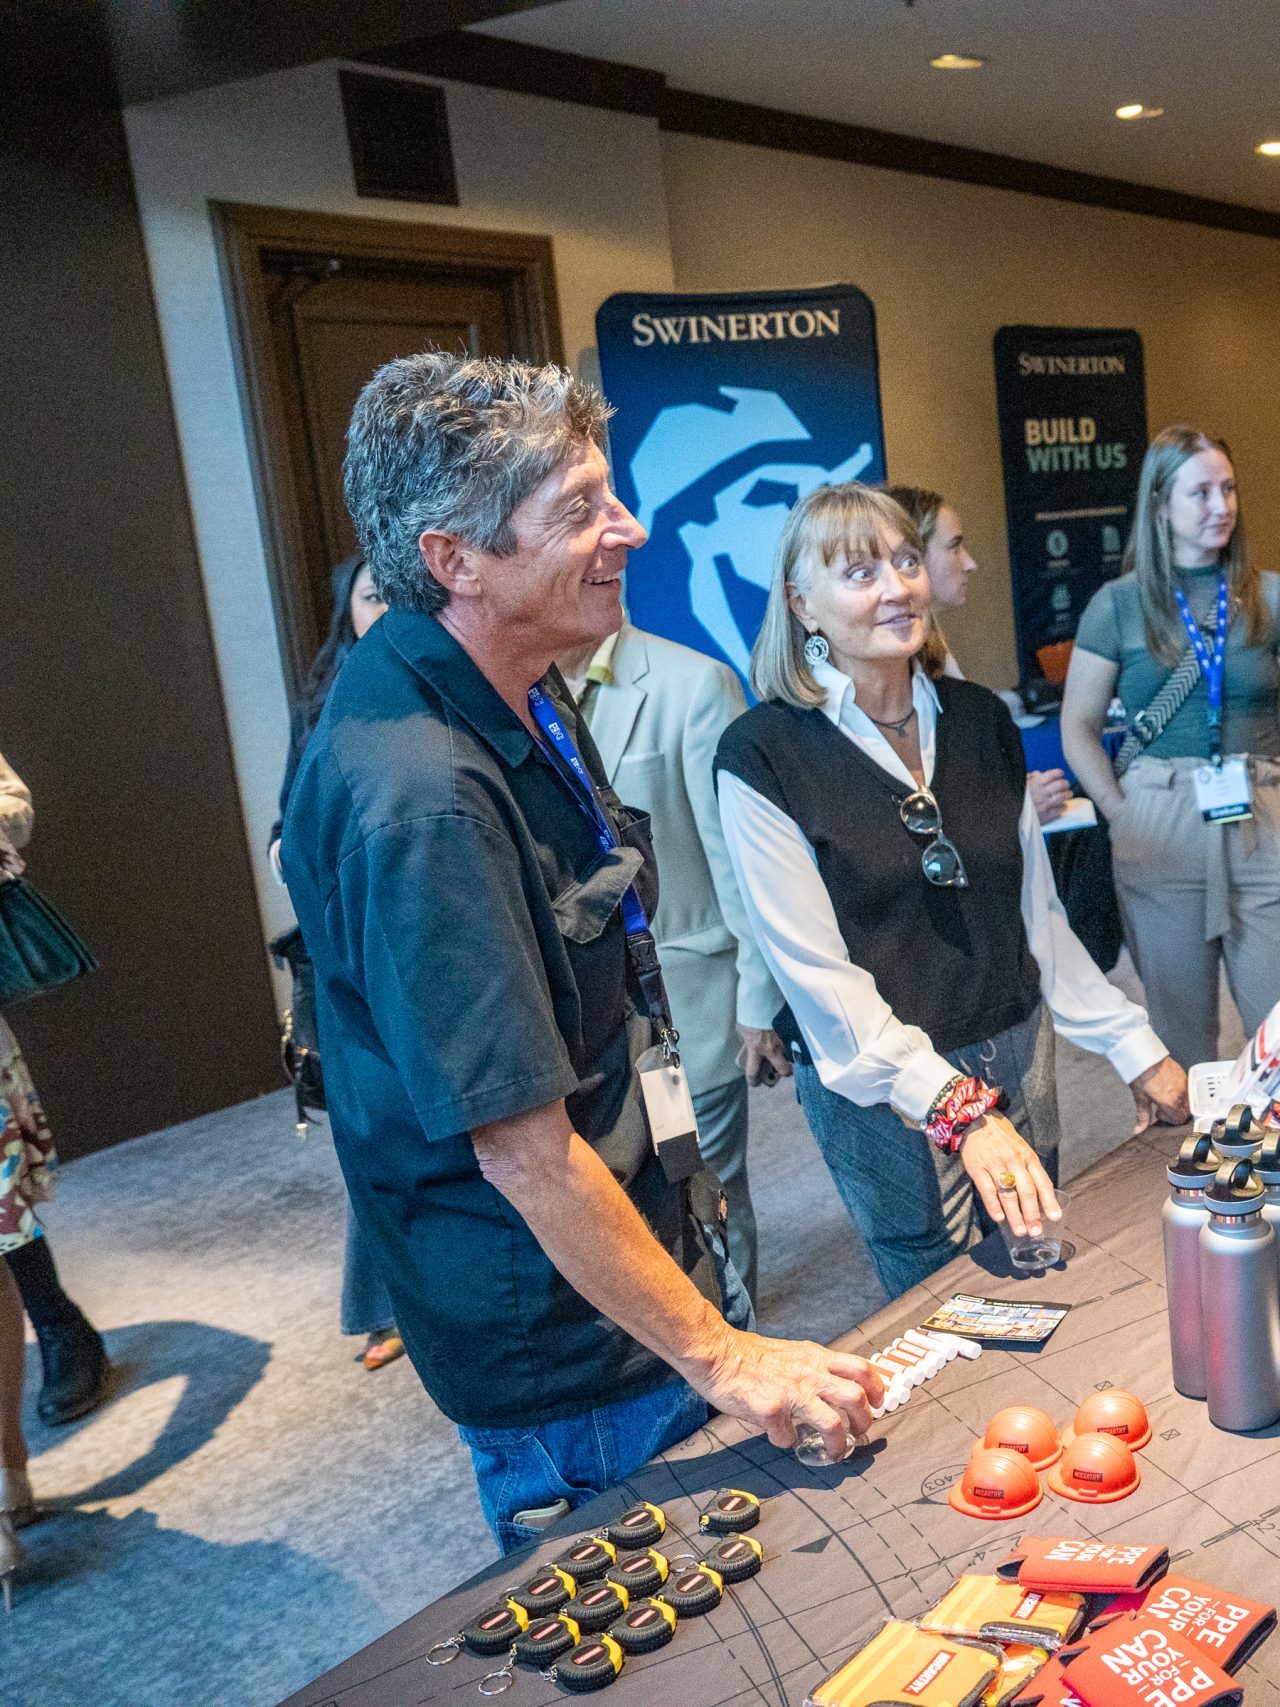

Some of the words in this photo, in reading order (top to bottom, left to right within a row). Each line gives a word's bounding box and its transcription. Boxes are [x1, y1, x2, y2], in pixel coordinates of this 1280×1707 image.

[632, 308, 841, 348] SWINERTON
[1024, 416, 1098, 446] BUILD
[1025, 444, 1092, 473] WITH
[1094, 441, 1128, 470] US
[1044, 1540, 1087, 1561] CAN
[1072, 1543, 1107, 1562] YOUR
[1106, 1545, 1150, 1565] PPE
[1167, 1595, 1212, 1632] YOUR
[1191, 1607, 1217, 1627] FOR
[1195, 1603, 1251, 1648] PPE
[1100, 1629, 1168, 1674] CAN
[1120, 1646, 1185, 1686] YOUR
[1144, 1666, 1215, 1707] PPE
[1149, 1664, 1181, 1687] FOR
